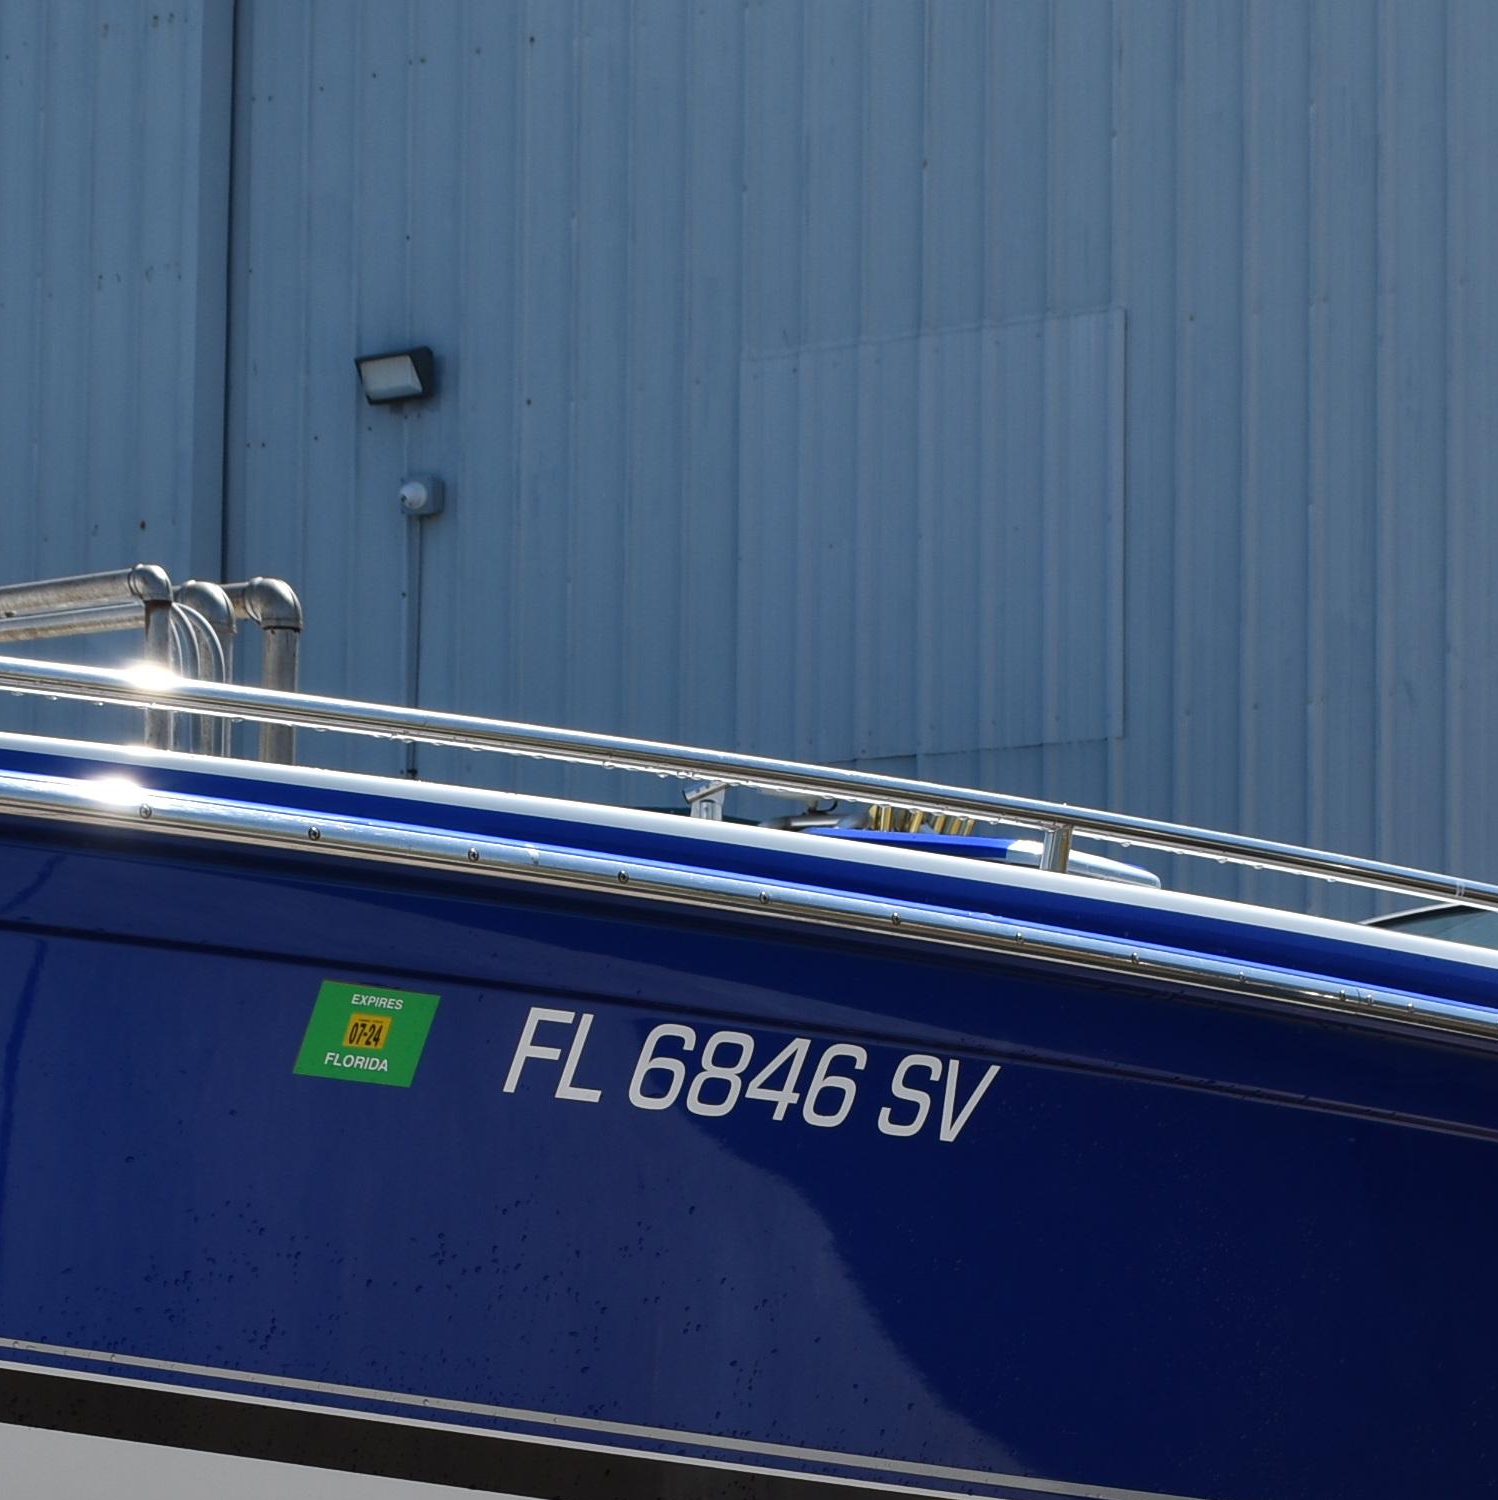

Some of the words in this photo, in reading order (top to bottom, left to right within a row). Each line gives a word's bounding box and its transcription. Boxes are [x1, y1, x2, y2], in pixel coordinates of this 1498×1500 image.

[351, 994, 404, 1010] EXPIRES
[349, 1022, 383, 1047] 07-24
[324, 1052, 389, 1072] FLORIDA
[503, 1006, 601, 1103] FL
[628, 1023, 868, 1128] 6846
[877, 1053, 1001, 1142] SV
